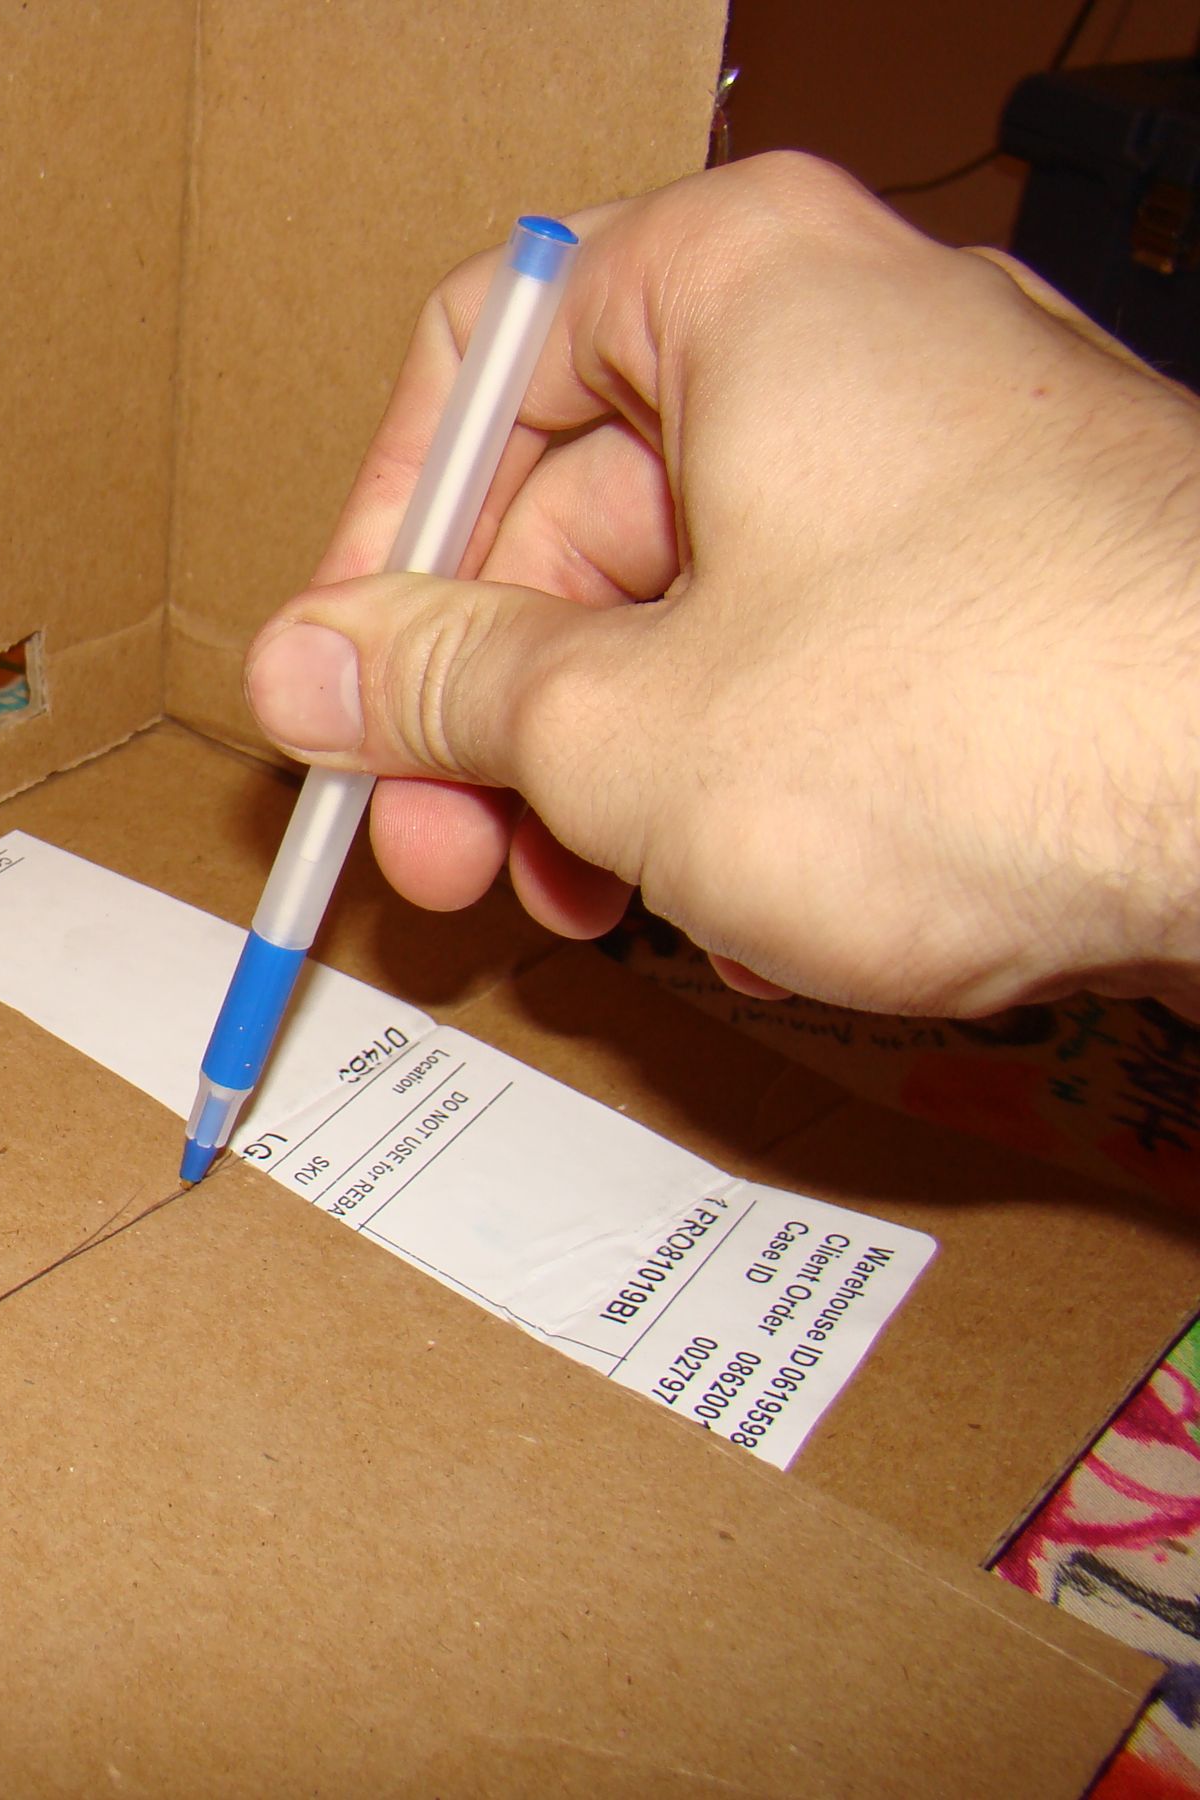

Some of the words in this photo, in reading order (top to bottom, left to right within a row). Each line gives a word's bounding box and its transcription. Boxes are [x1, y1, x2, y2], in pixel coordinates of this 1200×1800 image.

[392, 1049, 451, 1095] Location
[442, 1091, 469, 1112] DO
[415, 1109, 450, 1139] NOT
[385, 1137, 422, 1164] USE
[294, 1155, 330, 1186] SKU
[368, 1160, 395, 1181] for
[761, 1220, 809, 1261] Case
[796, 1233, 851, 1283] Client
[745, 1262, 778, 1284] ID
[758, 1283, 812, 1337] Order
[806, 1246, 895, 1342] Warehouse
[652, 1336, 719, 1405] 002797
[789, 1343, 824, 1368] ID
[730, 1366, 806, 1449] 0619598
